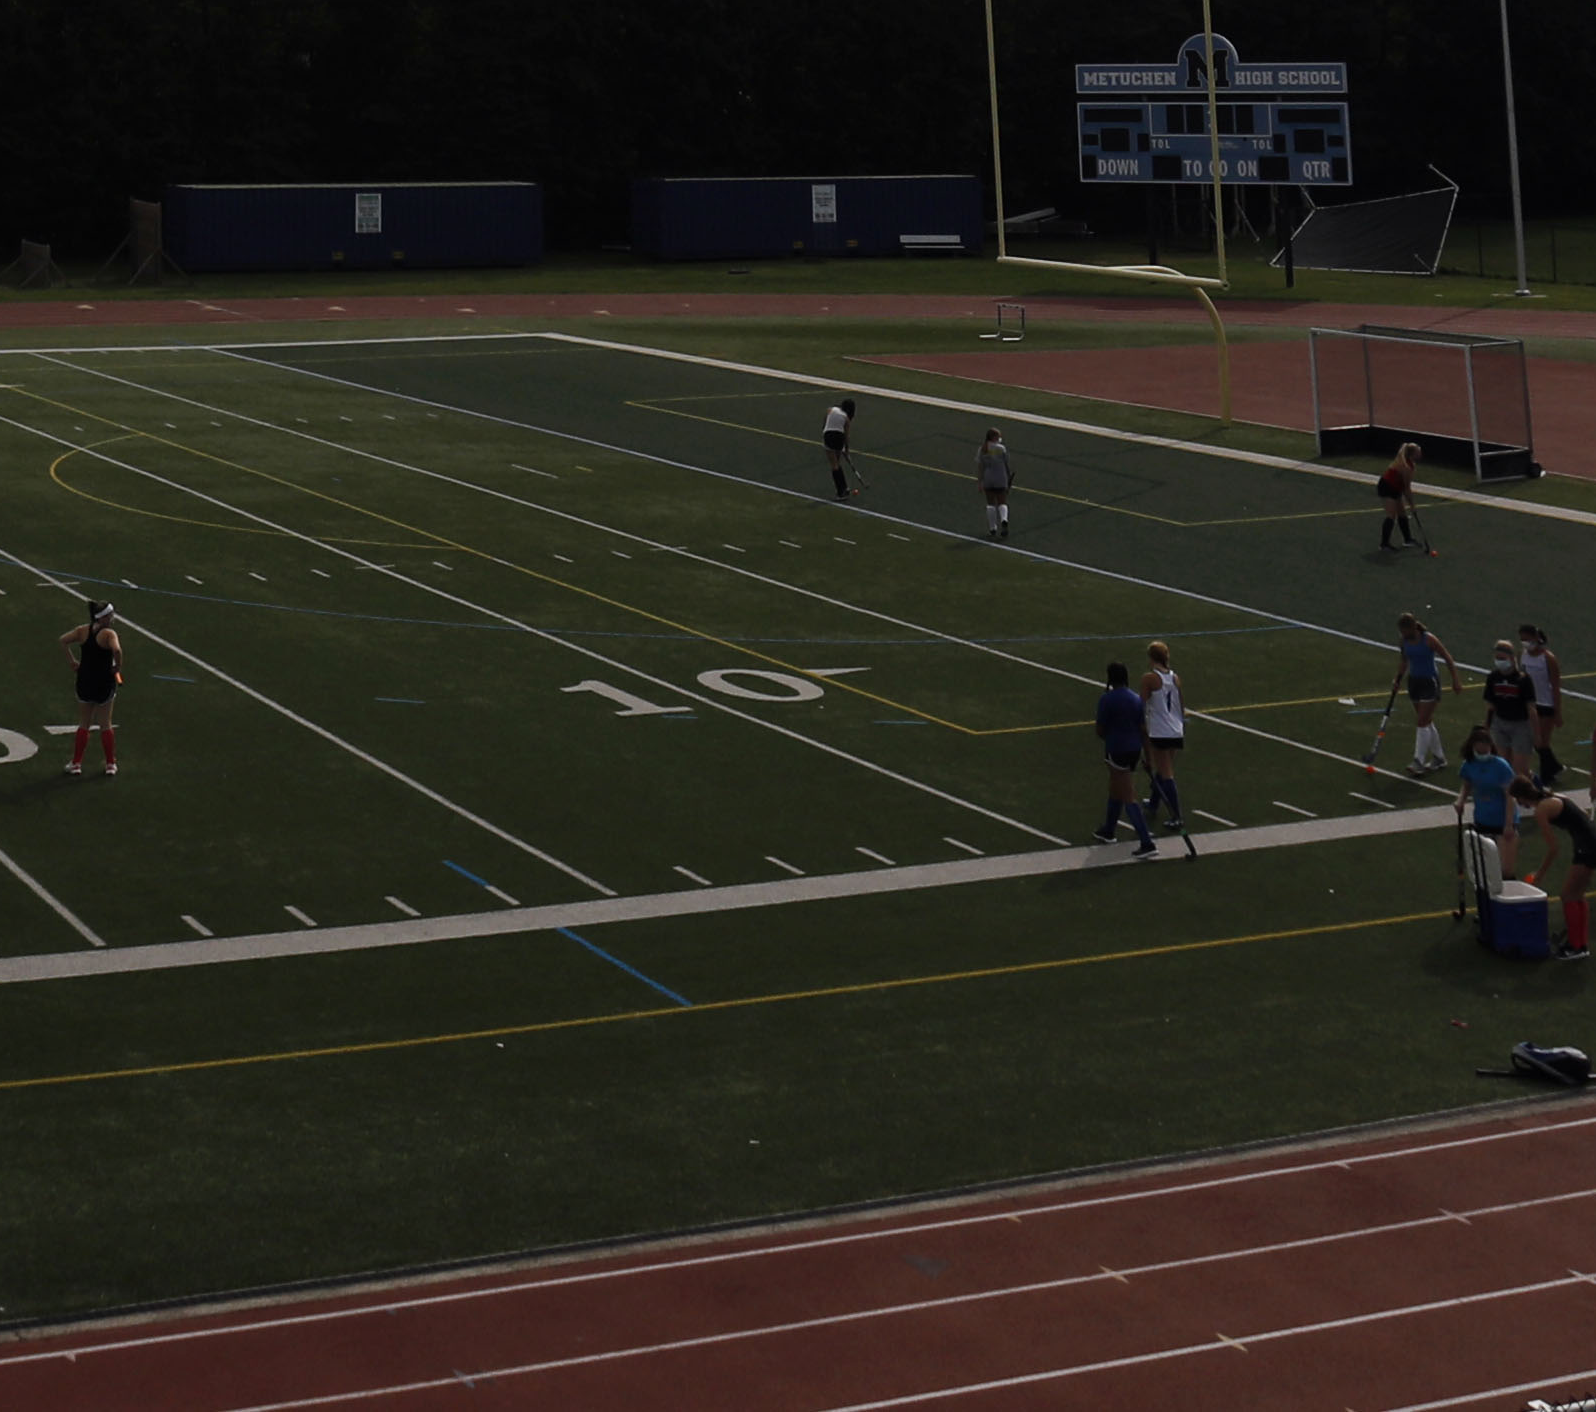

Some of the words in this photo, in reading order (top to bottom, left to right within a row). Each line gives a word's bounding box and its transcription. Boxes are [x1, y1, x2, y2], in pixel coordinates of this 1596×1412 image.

[1184, 49, 1231, 89] M
[1083, 71, 1177, 86] METUCHEN
[1234, 71, 1273, 86] HIGH
[1278, 71, 1340, 86] SCHOOL
[1151, 138, 1171, 150] TOL
[1252, 139, 1273, 151] TOL
[1097, 159, 1139, 176] DOWN
[1182, 160, 1203, 177] TO
[1237, 160, 1258, 177] ON
[1302, 160, 1331, 180] QTR
[560, 669, 825, 716] 10
